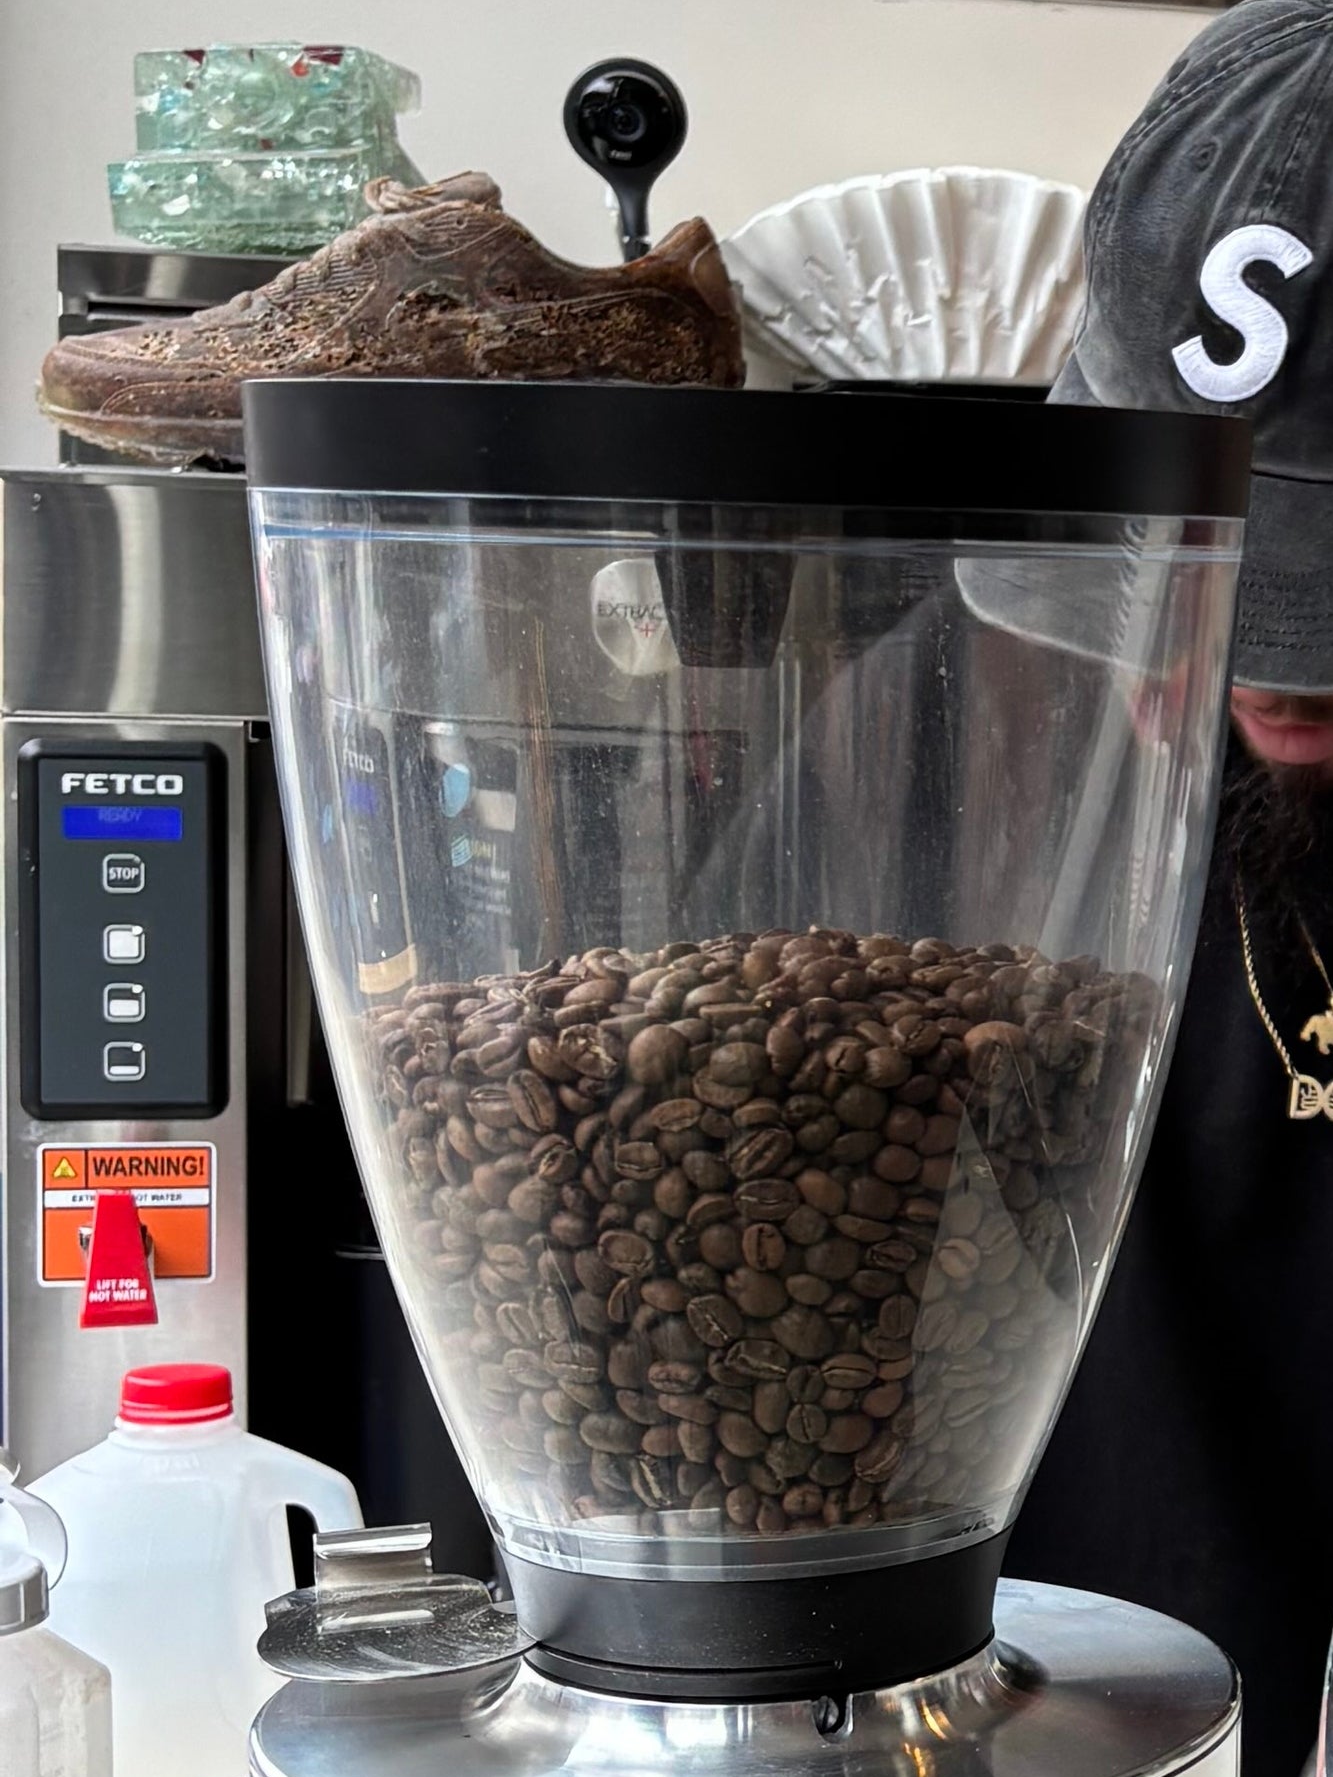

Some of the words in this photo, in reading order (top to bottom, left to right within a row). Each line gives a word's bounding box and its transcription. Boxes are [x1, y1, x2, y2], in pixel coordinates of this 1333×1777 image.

[1172, 224, 1314, 402] S
[62, 773, 182, 794] FETCO
[109, 867, 139, 880] STOP
[93, 1156, 204, 1176] WARNING!
[113, 1289, 147, 1301] WATER
